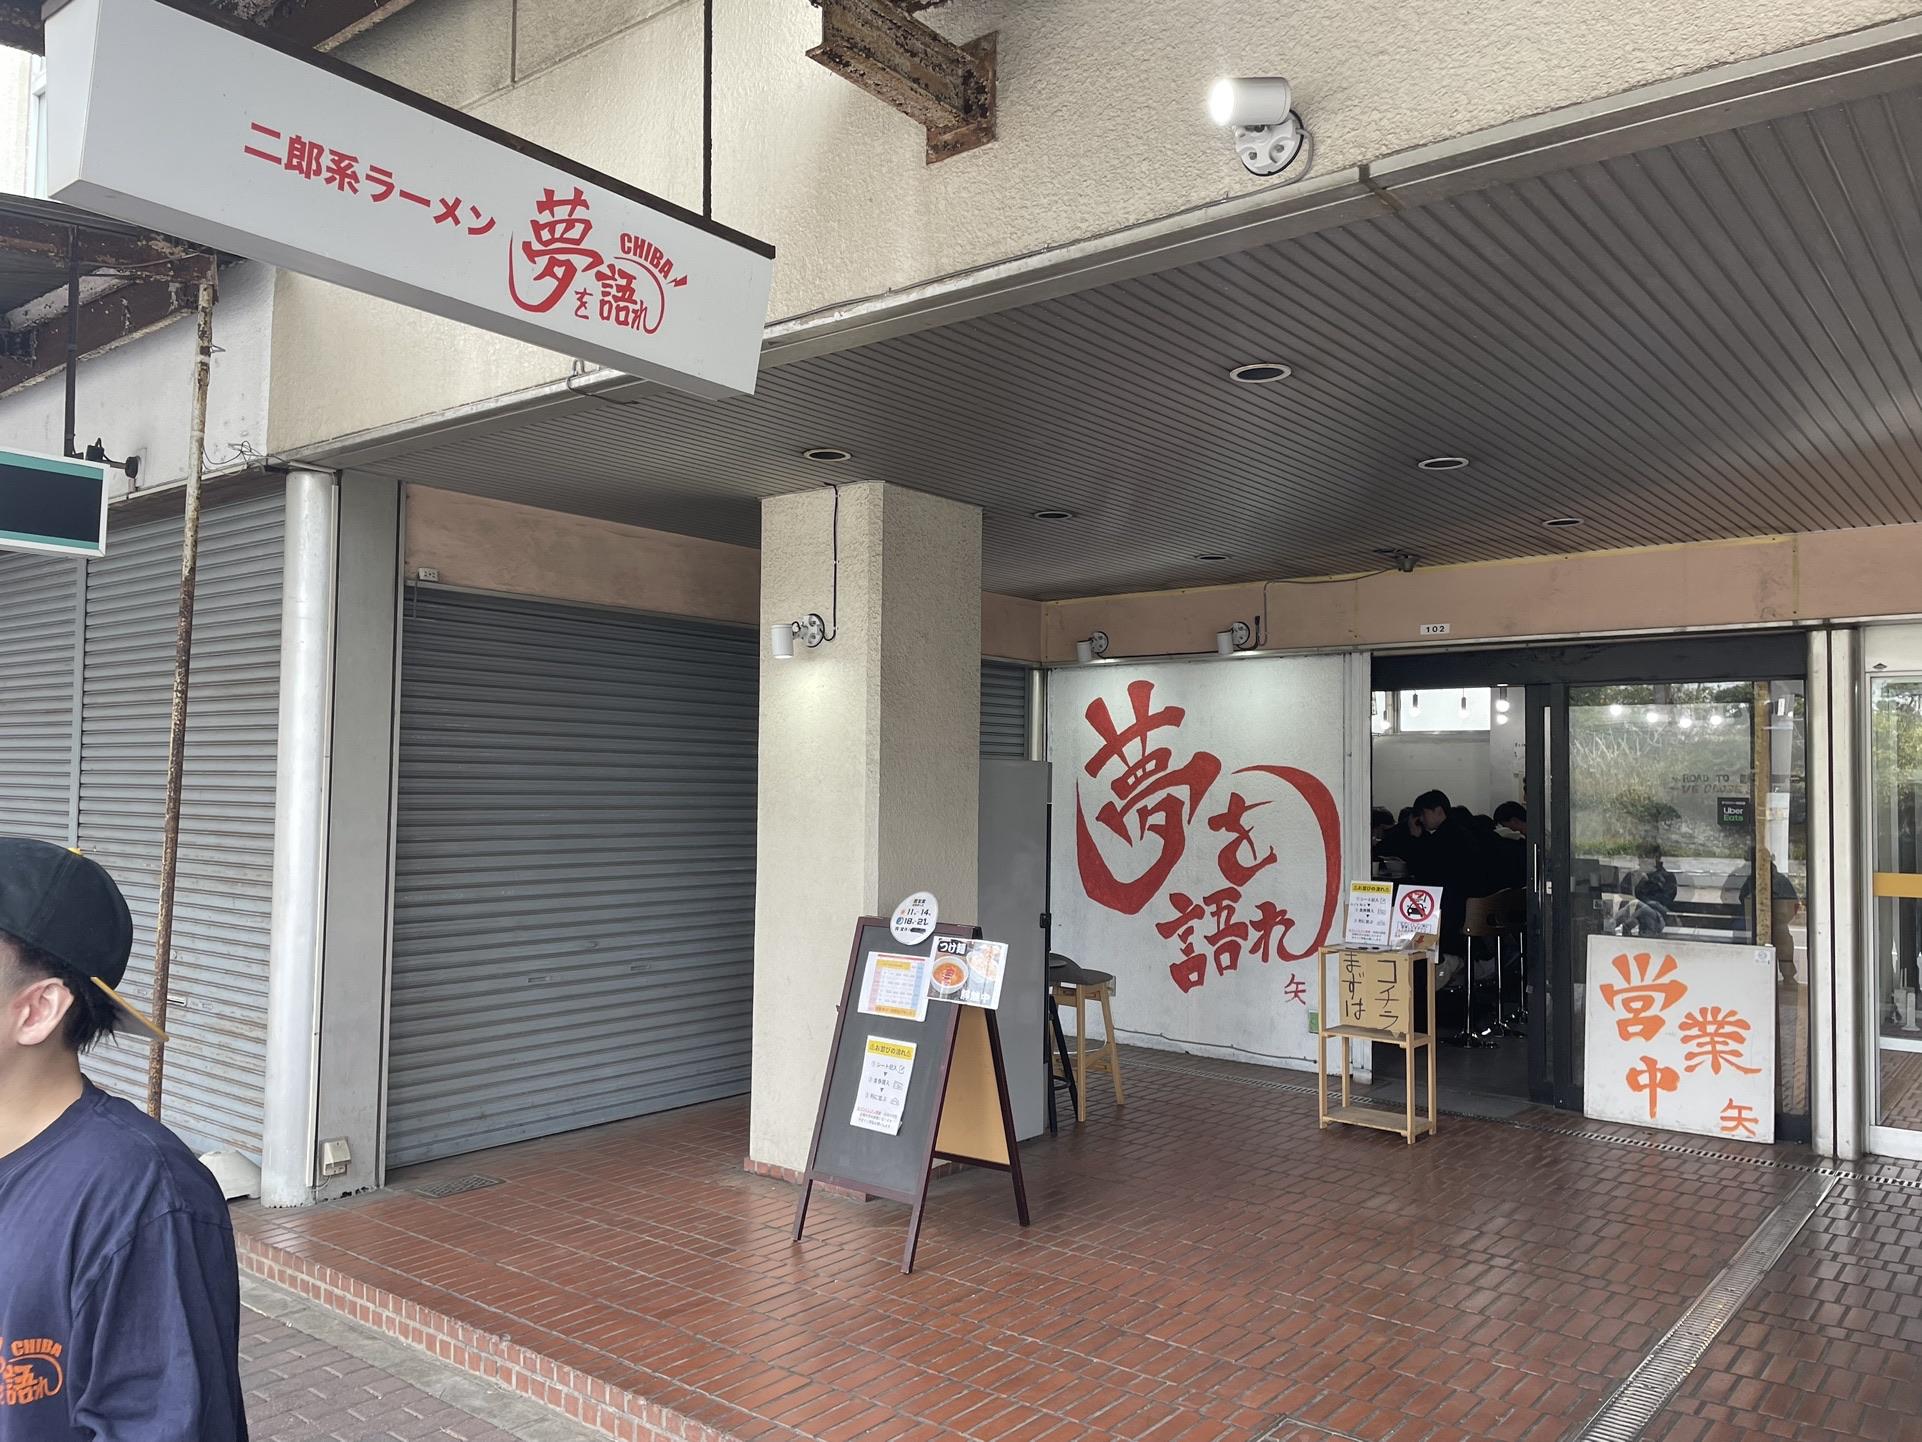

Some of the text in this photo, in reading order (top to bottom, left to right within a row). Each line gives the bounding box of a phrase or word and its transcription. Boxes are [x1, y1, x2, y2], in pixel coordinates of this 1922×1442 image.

[244, 122, 496, 236] 二郎系ラーメン
[619, 232, 674, 280] CHIBA
[1426, 625, 1445, 633] 102
[1723, 807, 1744, 815] Uber
[1723, 814, 1744, 822] Eats
[940, 942, 967, 955] つけ麺
[1284, 973, 1307, 1005] 矢
[1342, 951, 1366, 1021] まずは
[1375, 959, 1400, 1030] コチラ
[1719, 1097, 1760, 1136] 矢
[11, 1338, 62, 1357] CHIBA
